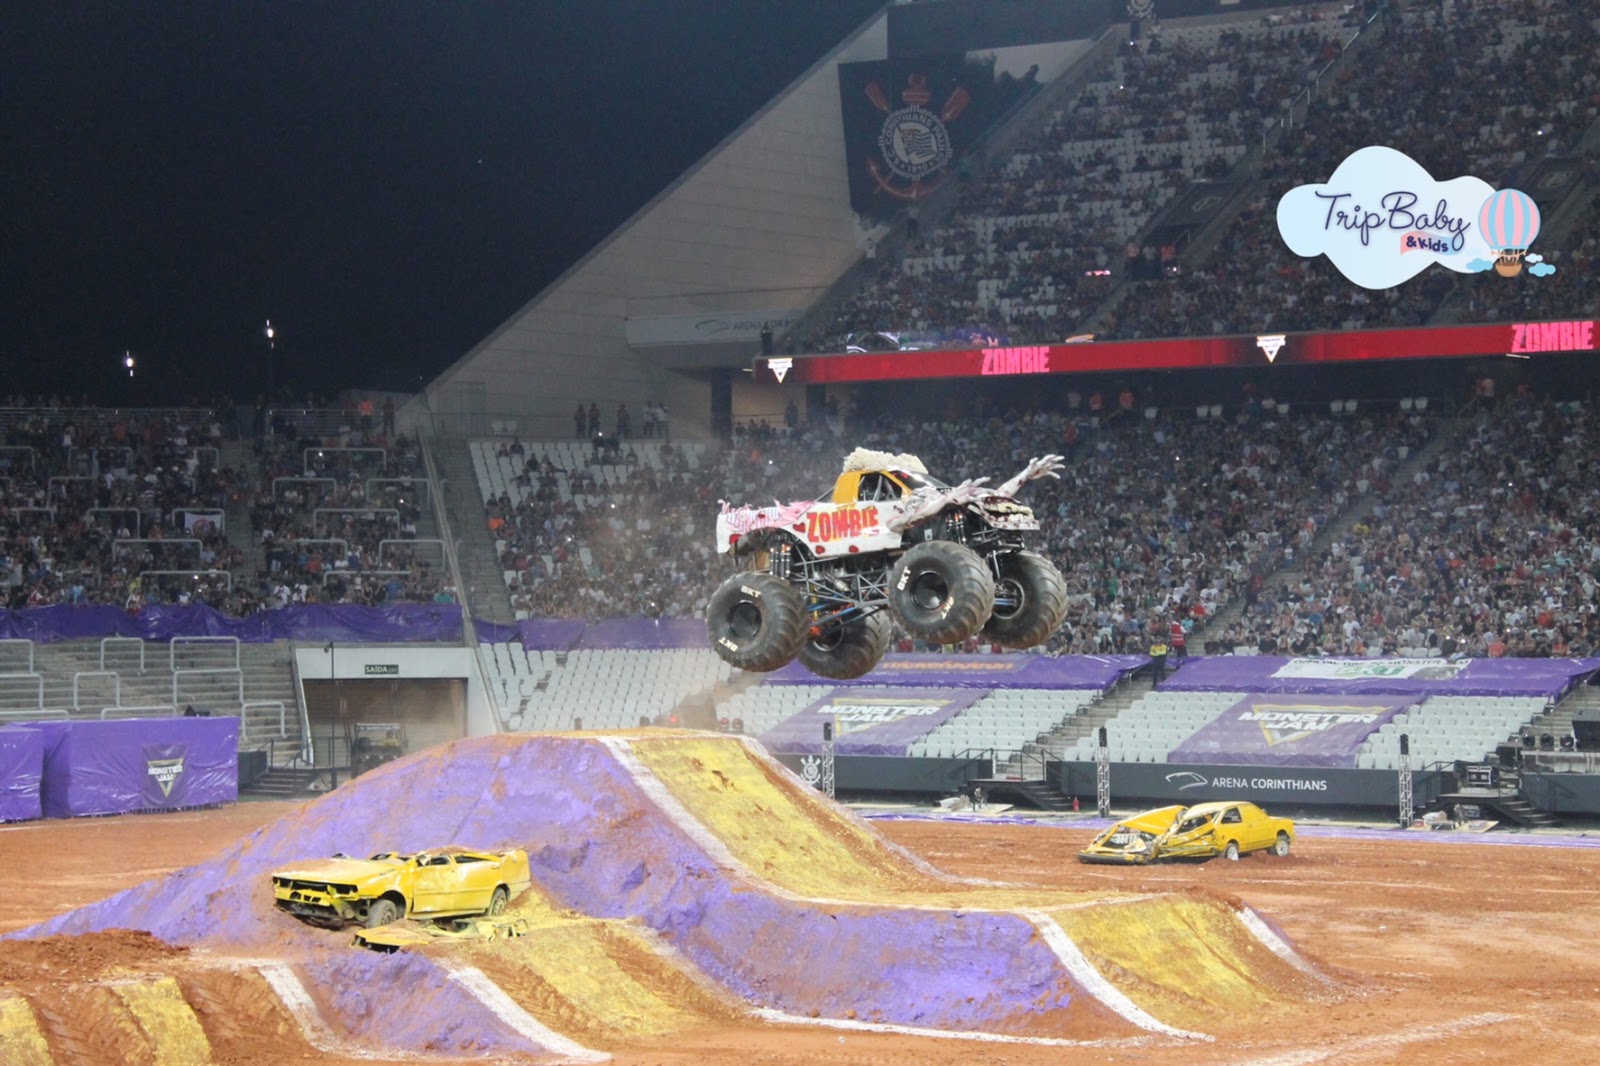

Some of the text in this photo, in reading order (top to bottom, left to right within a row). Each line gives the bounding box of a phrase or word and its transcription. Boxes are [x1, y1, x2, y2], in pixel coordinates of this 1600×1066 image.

[1511, 321, 1595, 353] ZOMBIE
[981, 345, 1050, 375] ZOMBIE
[806, 508, 879, 543] ZOMBIE
[896, 566, 911, 591] BKT
[740, 585, 762, 598] BKT
[717, 636, 739, 653] BKT
[817, 704, 941, 716] MONSTER
[840, 713, 894, 722] JAM
[1237, 711, 1379, 724] MONSTER
[1265, 720, 1330, 731] JAM
[1212, 777, 1327, 791] ARENA CORINTHIANS
